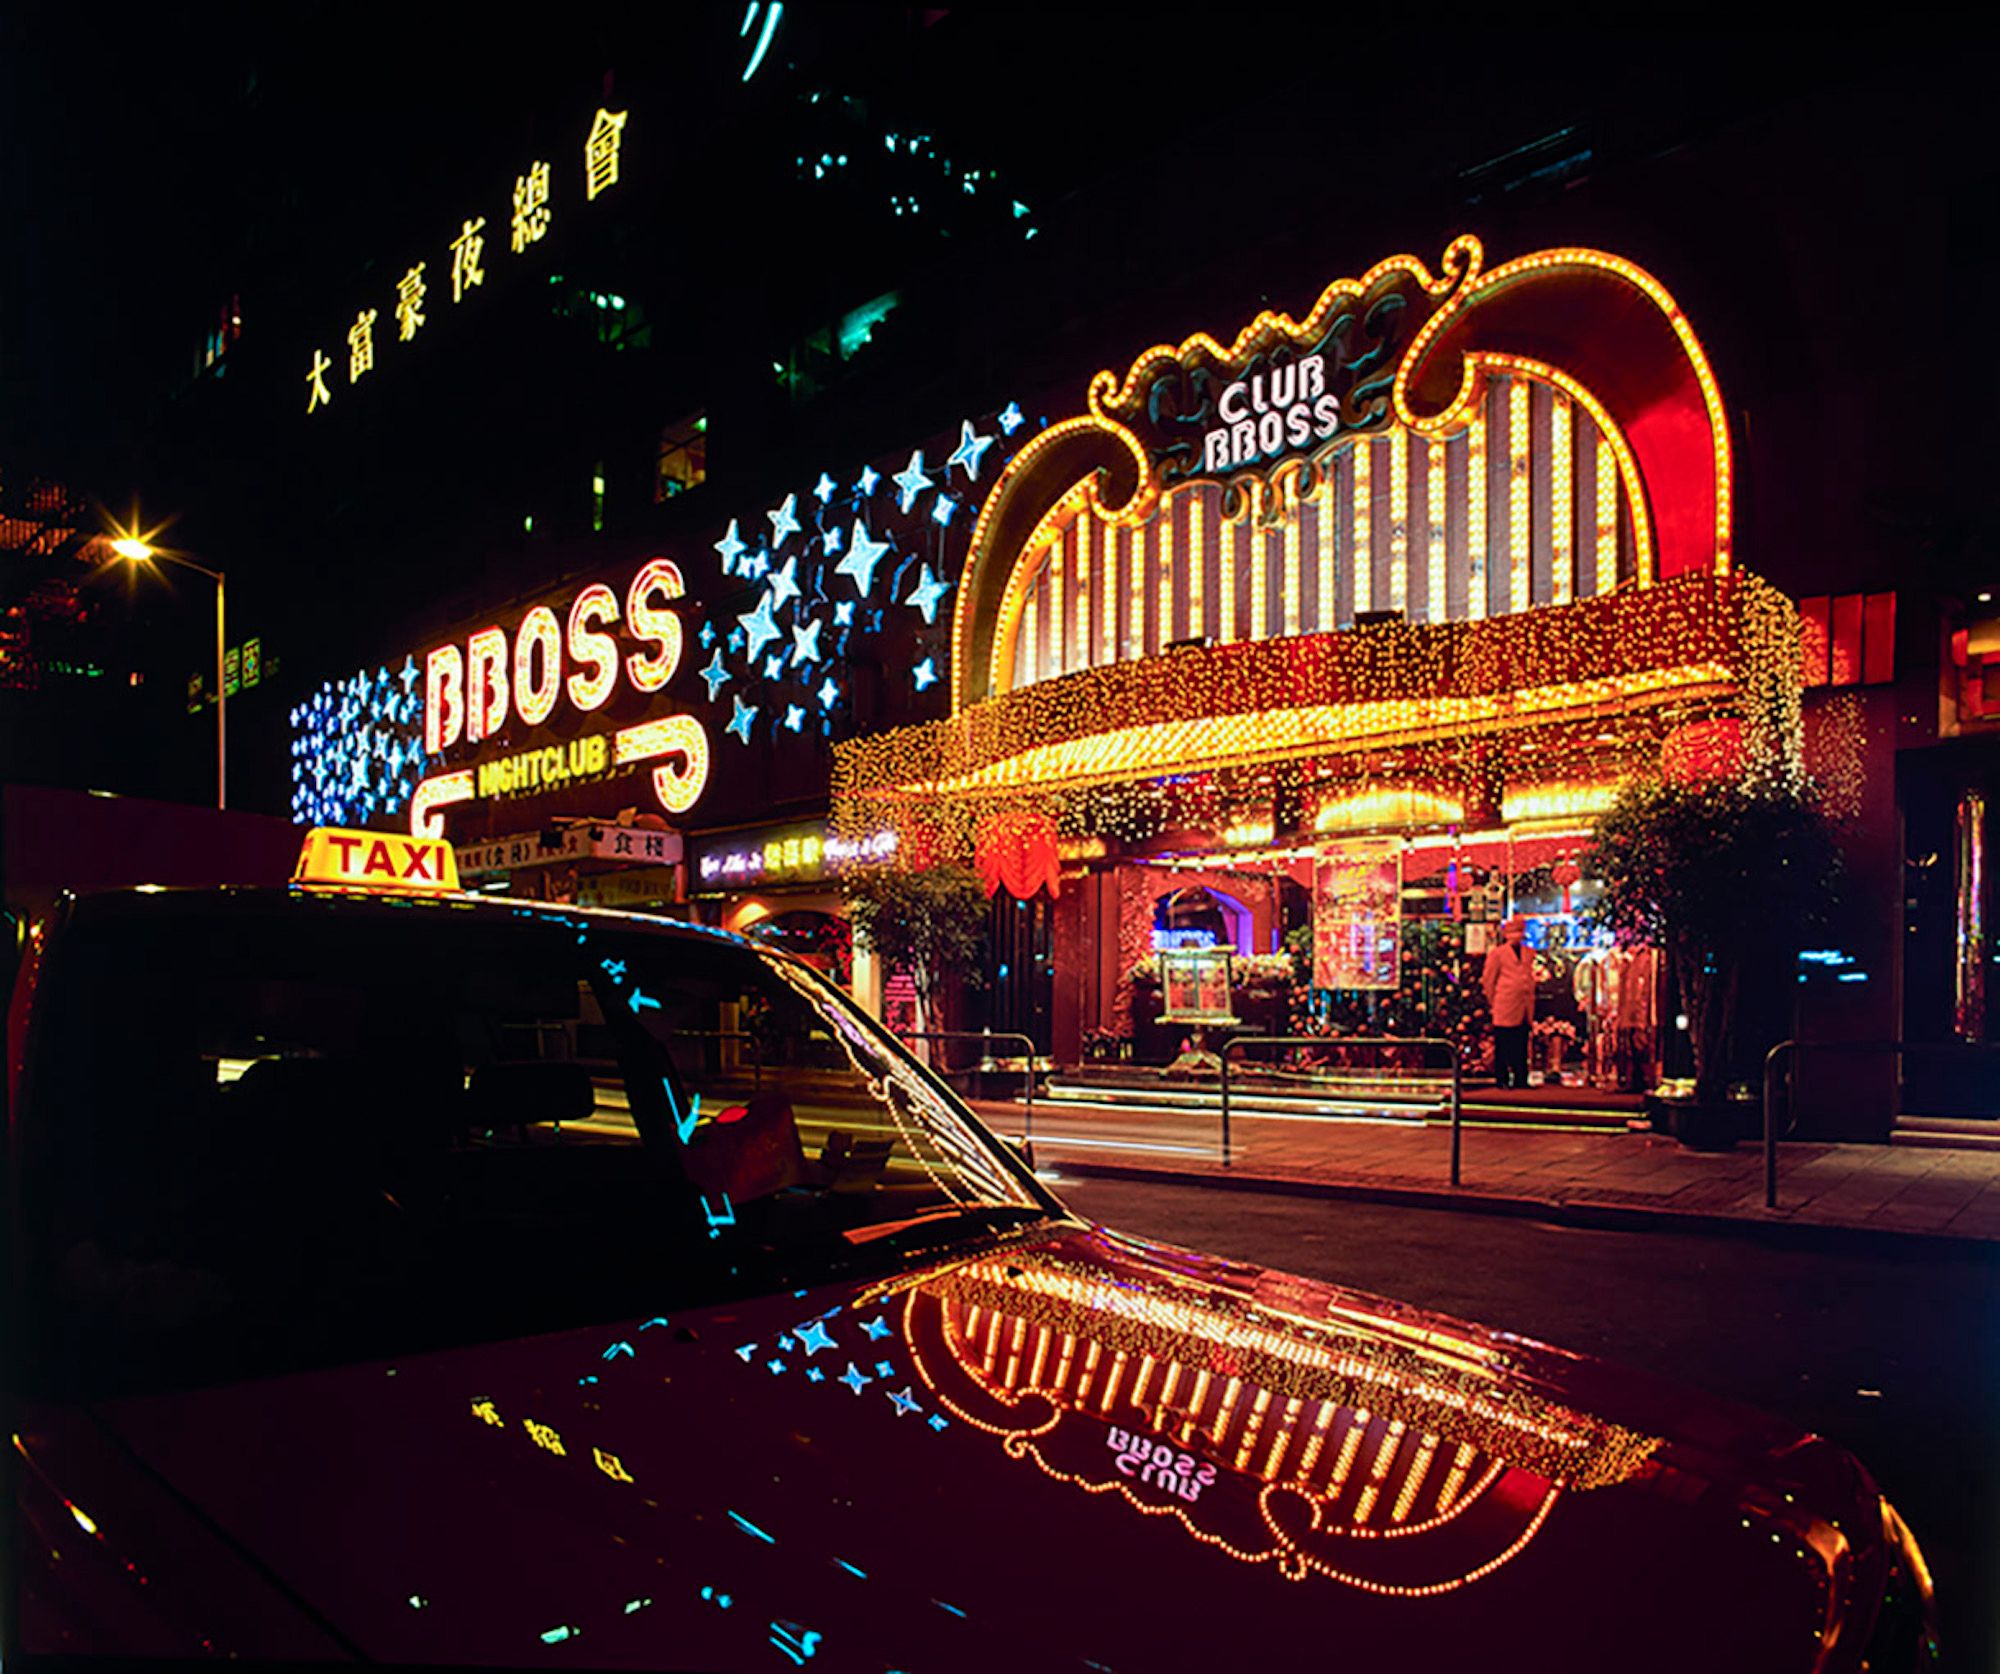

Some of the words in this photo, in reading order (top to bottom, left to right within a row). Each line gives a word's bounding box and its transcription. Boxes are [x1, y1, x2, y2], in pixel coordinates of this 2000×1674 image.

[306, 107, 628, 414] 大富豪夜總會
[1218, 354, 1325, 425] CLUB
[1204, 394, 1341, 472] BBOSS
[425, 557, 686, 754] BBOSS
[478, 734, 607, 798] NIGHTCLUB
[328, 834, 446, 881] TAXI
